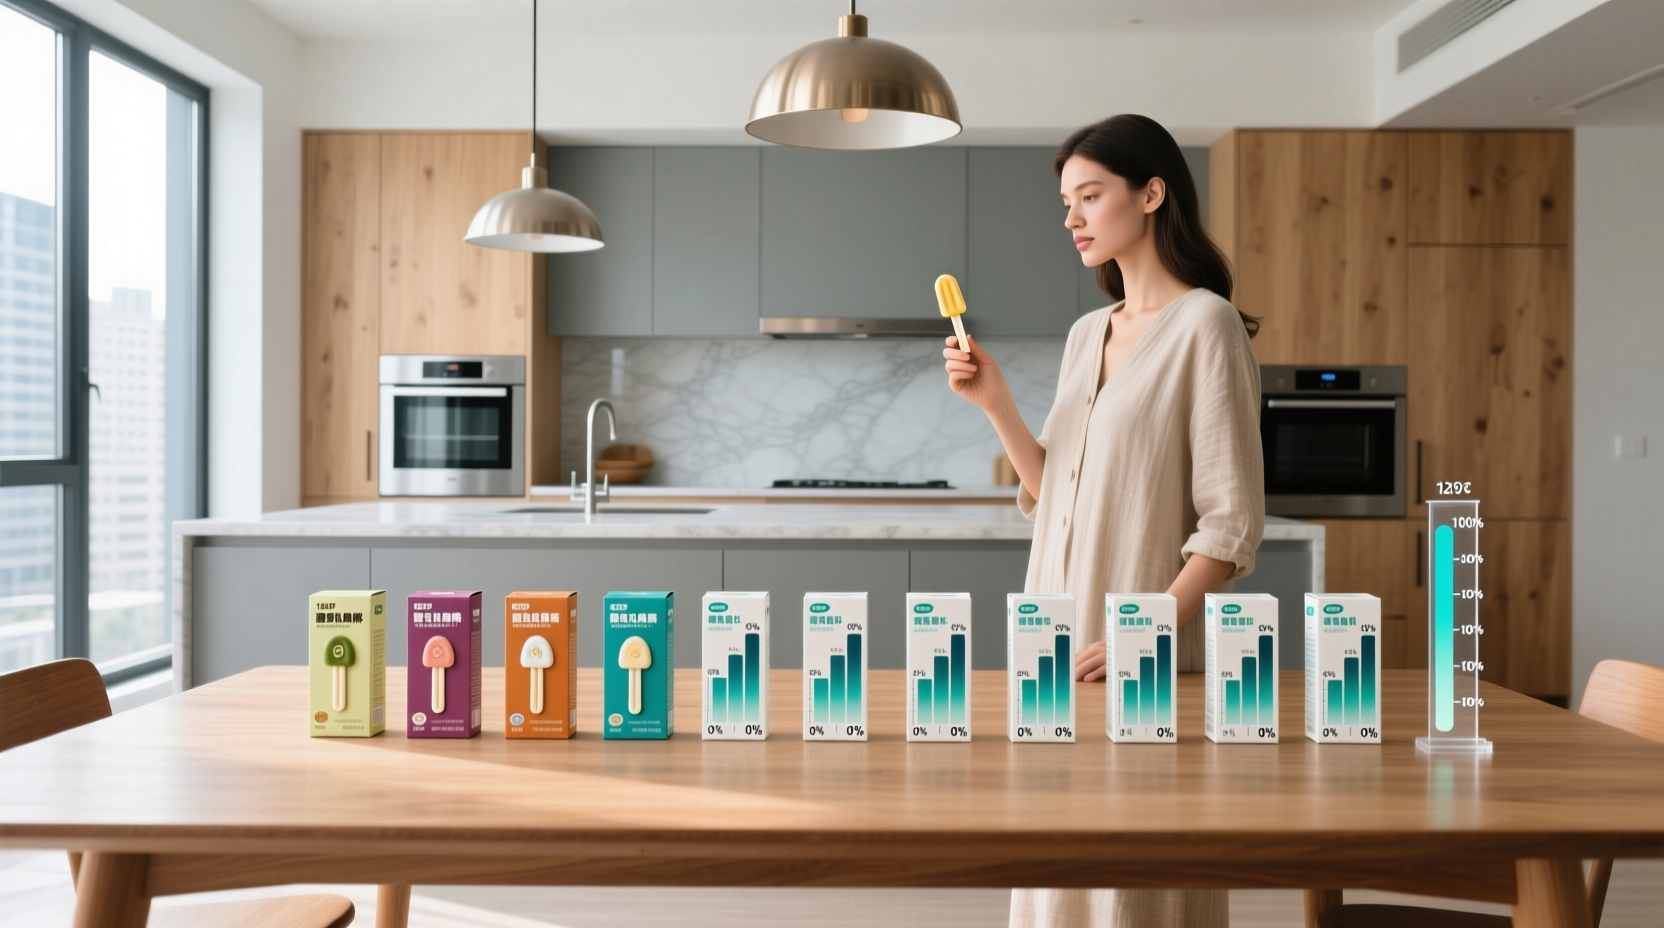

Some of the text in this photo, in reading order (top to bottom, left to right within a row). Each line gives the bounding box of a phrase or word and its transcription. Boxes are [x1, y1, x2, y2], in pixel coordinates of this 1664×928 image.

[1451, 516, 1484, 529] 100%
[1258, 727, 1275, 738] 0%
[1360, 727, 1378, 739] 0%
